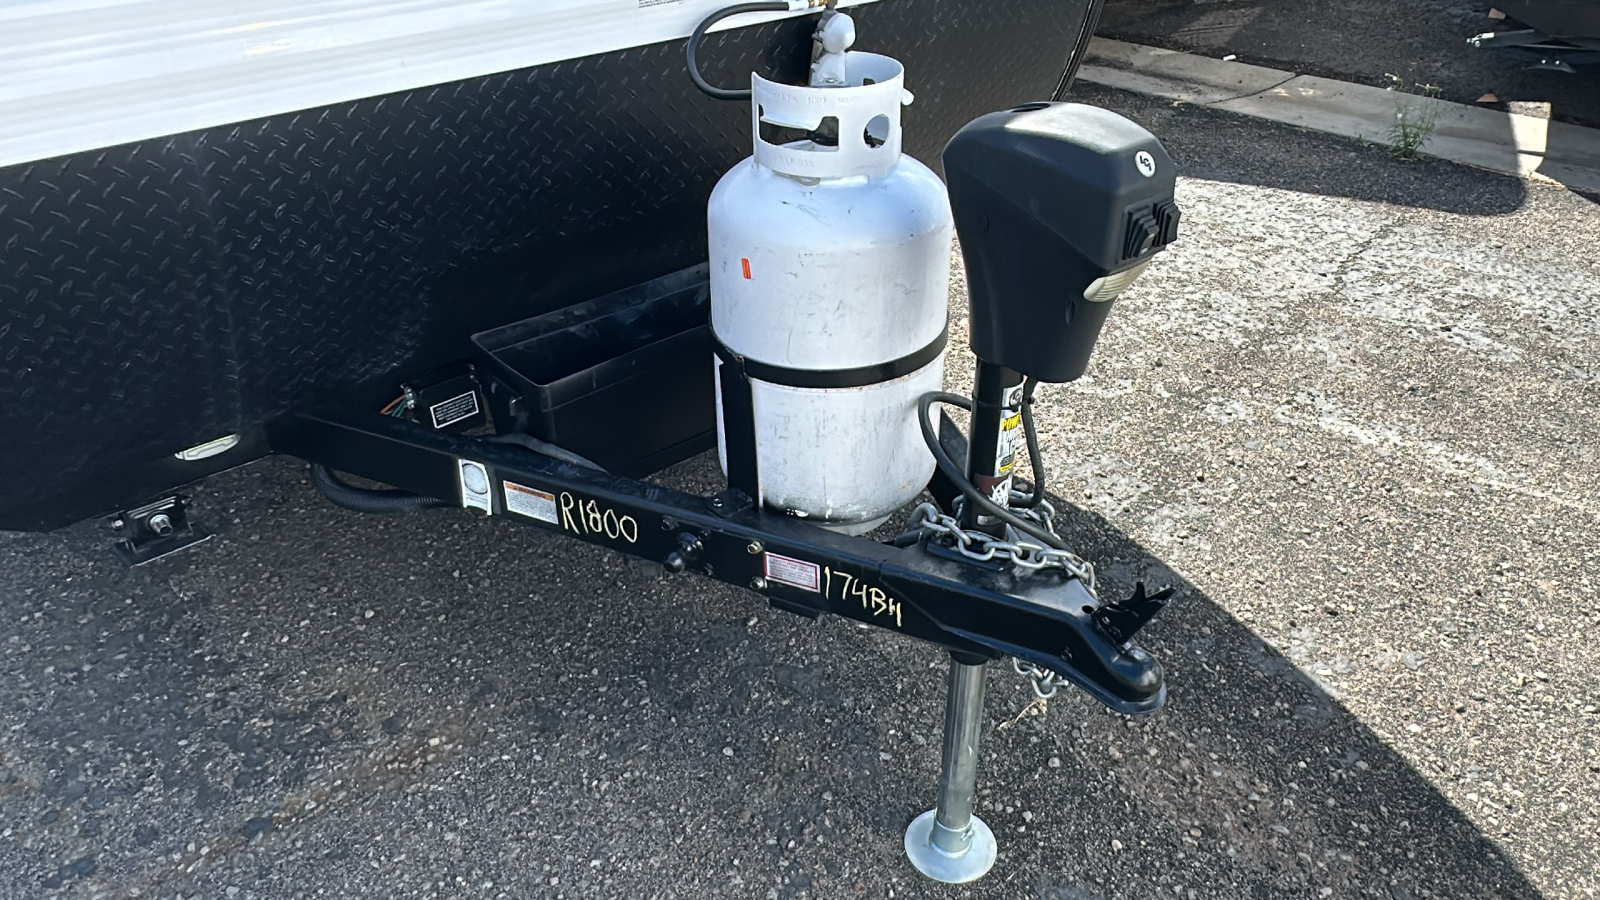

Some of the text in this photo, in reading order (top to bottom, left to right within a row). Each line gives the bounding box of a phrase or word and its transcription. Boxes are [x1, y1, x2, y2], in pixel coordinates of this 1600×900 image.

[1139, 155, 1152, 171] LCI
[559, 491, 638, 544] R1800
[824, 565, 903, 628] 174BH
